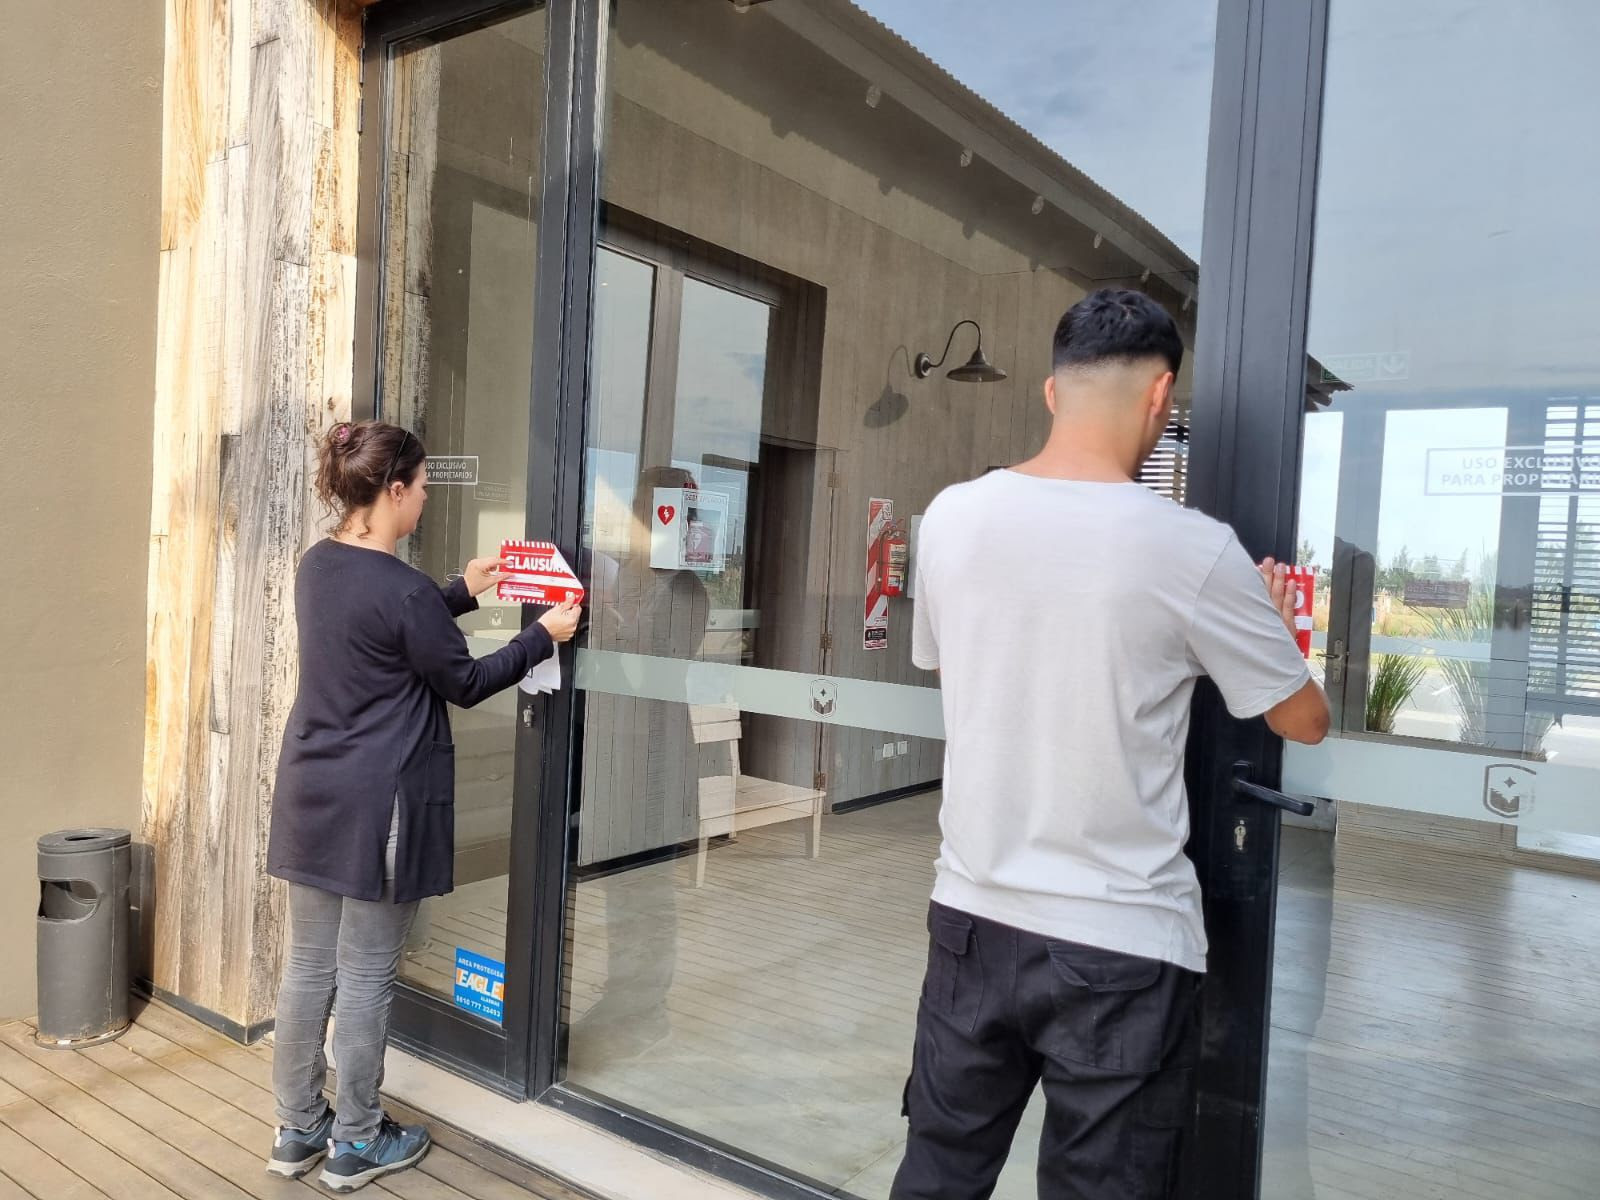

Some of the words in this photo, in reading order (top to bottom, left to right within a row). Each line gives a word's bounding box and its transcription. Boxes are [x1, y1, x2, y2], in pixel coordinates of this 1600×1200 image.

[436, 462, 467, 470] EXCLUSIVO
[1462, 456, 1497, 469] USO
[432, 471, 473, 479] PROPIETARIOS
[1442, 473, 1486, 486] PARA
[458, 957, 473, 968] AREA
[456, 968, 505, 1001] EAGLE
